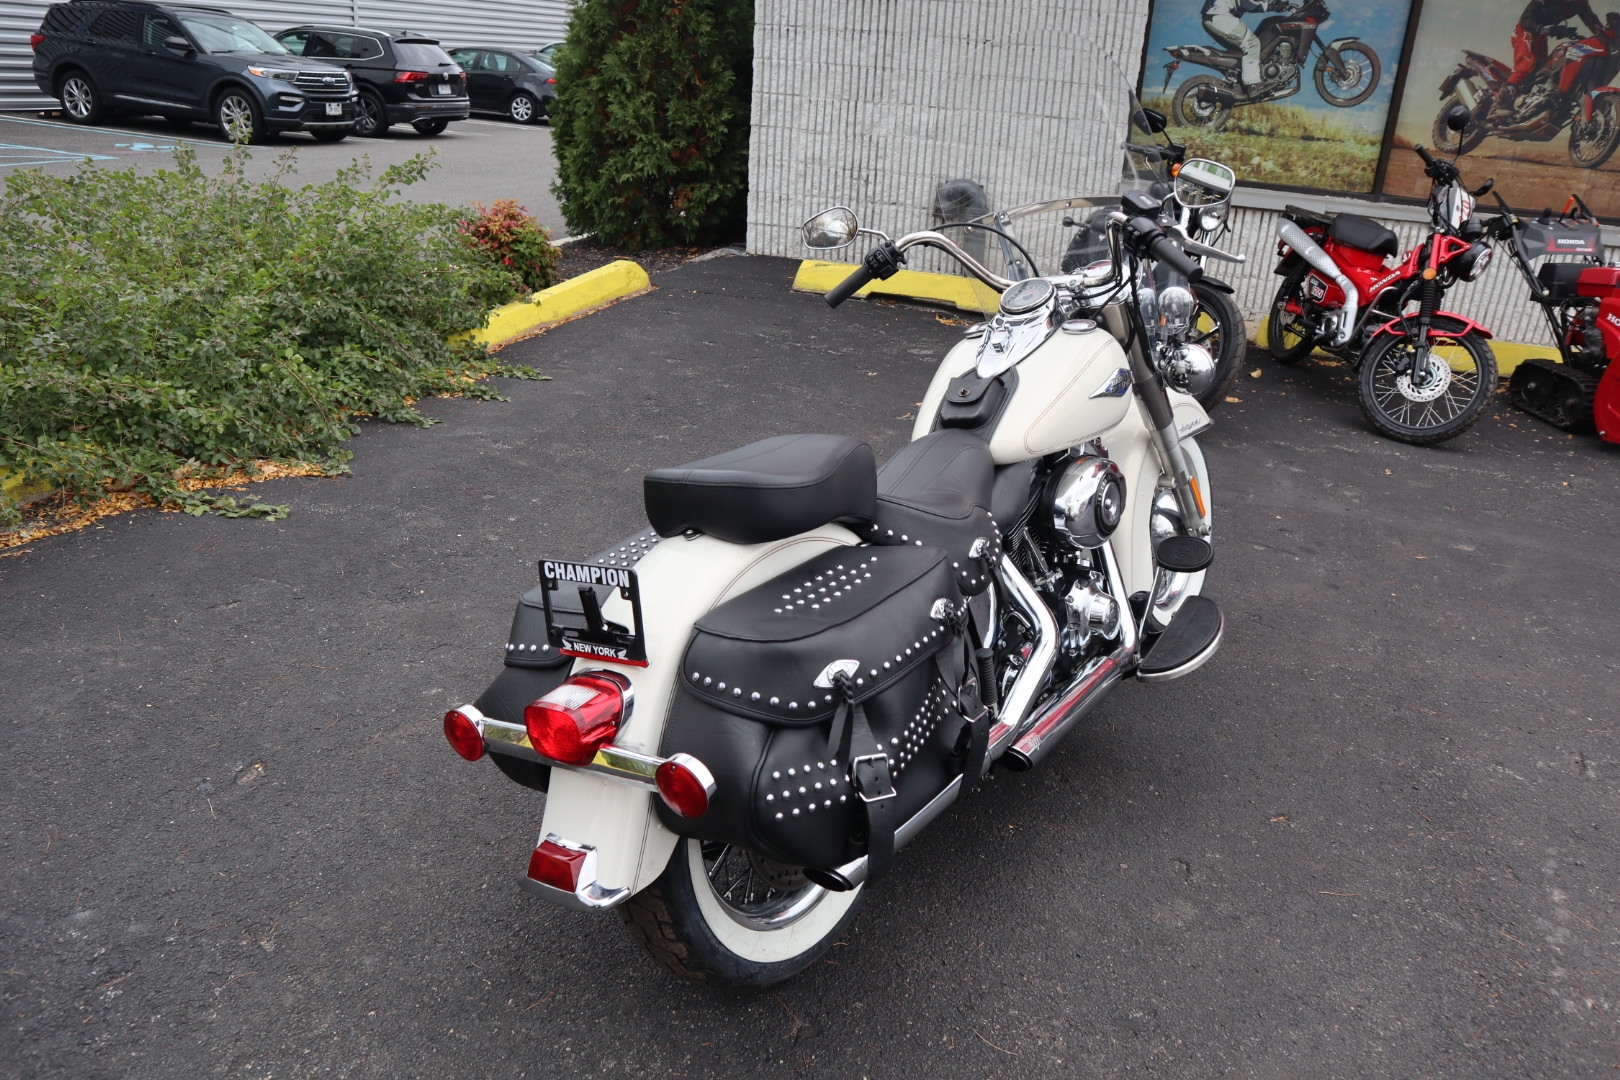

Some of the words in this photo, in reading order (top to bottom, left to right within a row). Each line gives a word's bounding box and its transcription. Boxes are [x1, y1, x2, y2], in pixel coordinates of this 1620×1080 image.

[1557, 238, 1586, 246] HONDA
[1369, 270, 1402, 293] HONDA
[543, 561, 630, 589] CHAMPION
[573, 642, 592, 654] NEW
[593, 645, 617, 659] YORK
